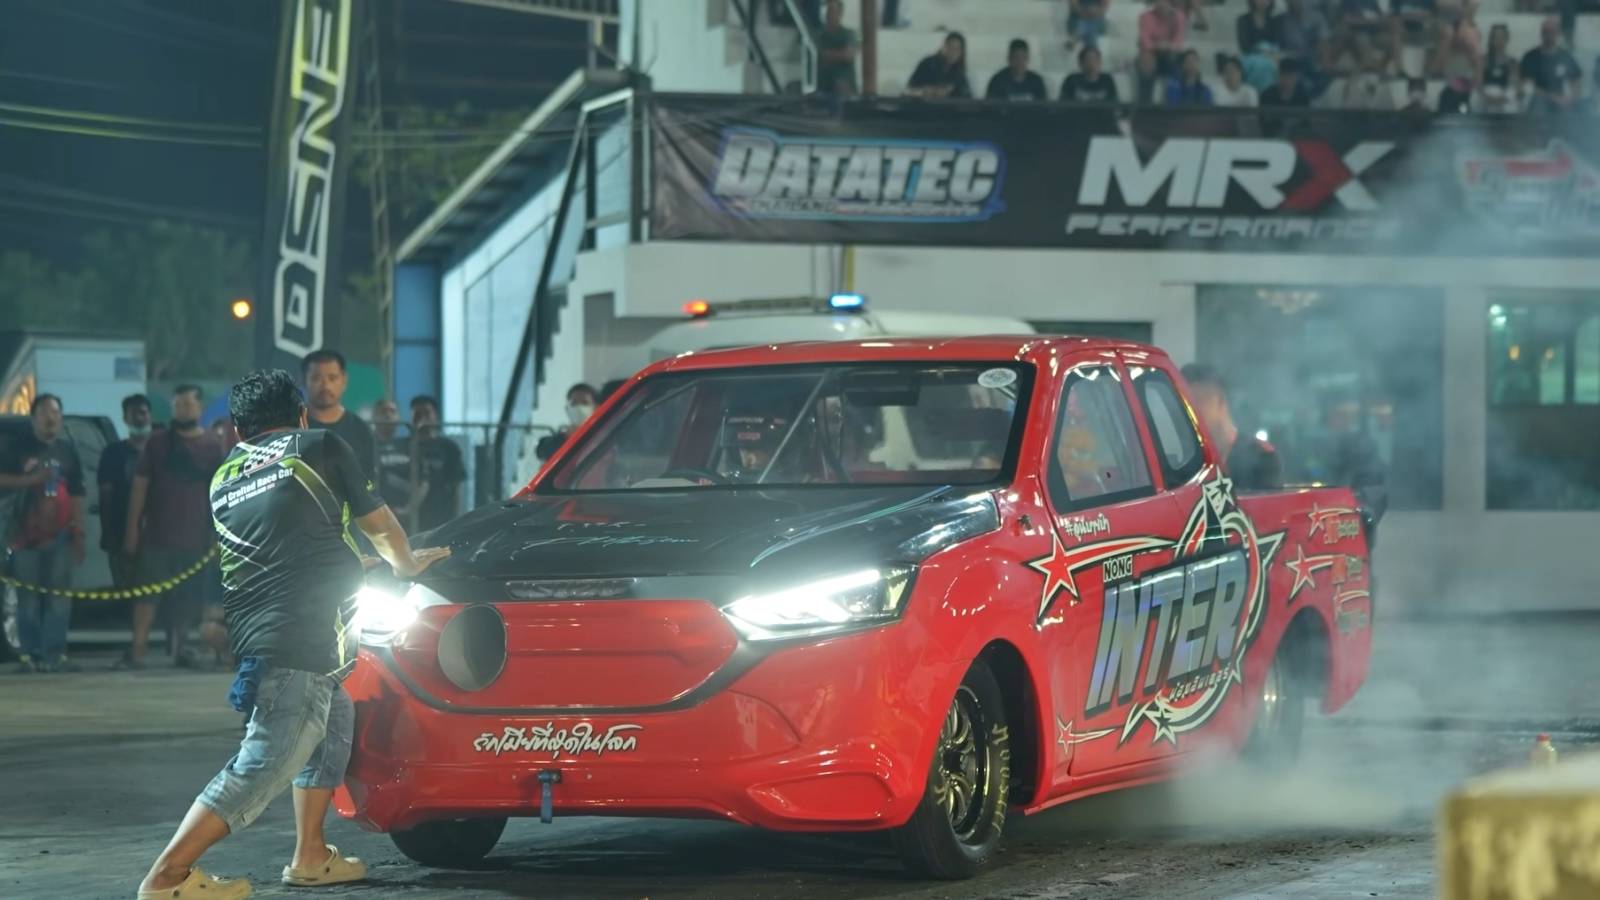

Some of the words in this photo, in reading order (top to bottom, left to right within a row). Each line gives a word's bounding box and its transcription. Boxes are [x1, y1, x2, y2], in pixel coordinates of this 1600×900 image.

[713, 135, 998, 203] DATATEC
[1077, 136, 1395, 210] MRX
[278, 467, 295, 480] Car
[1104, 556, 1133, 582] NONG
[1086, 551, 1249, 714] INTER
